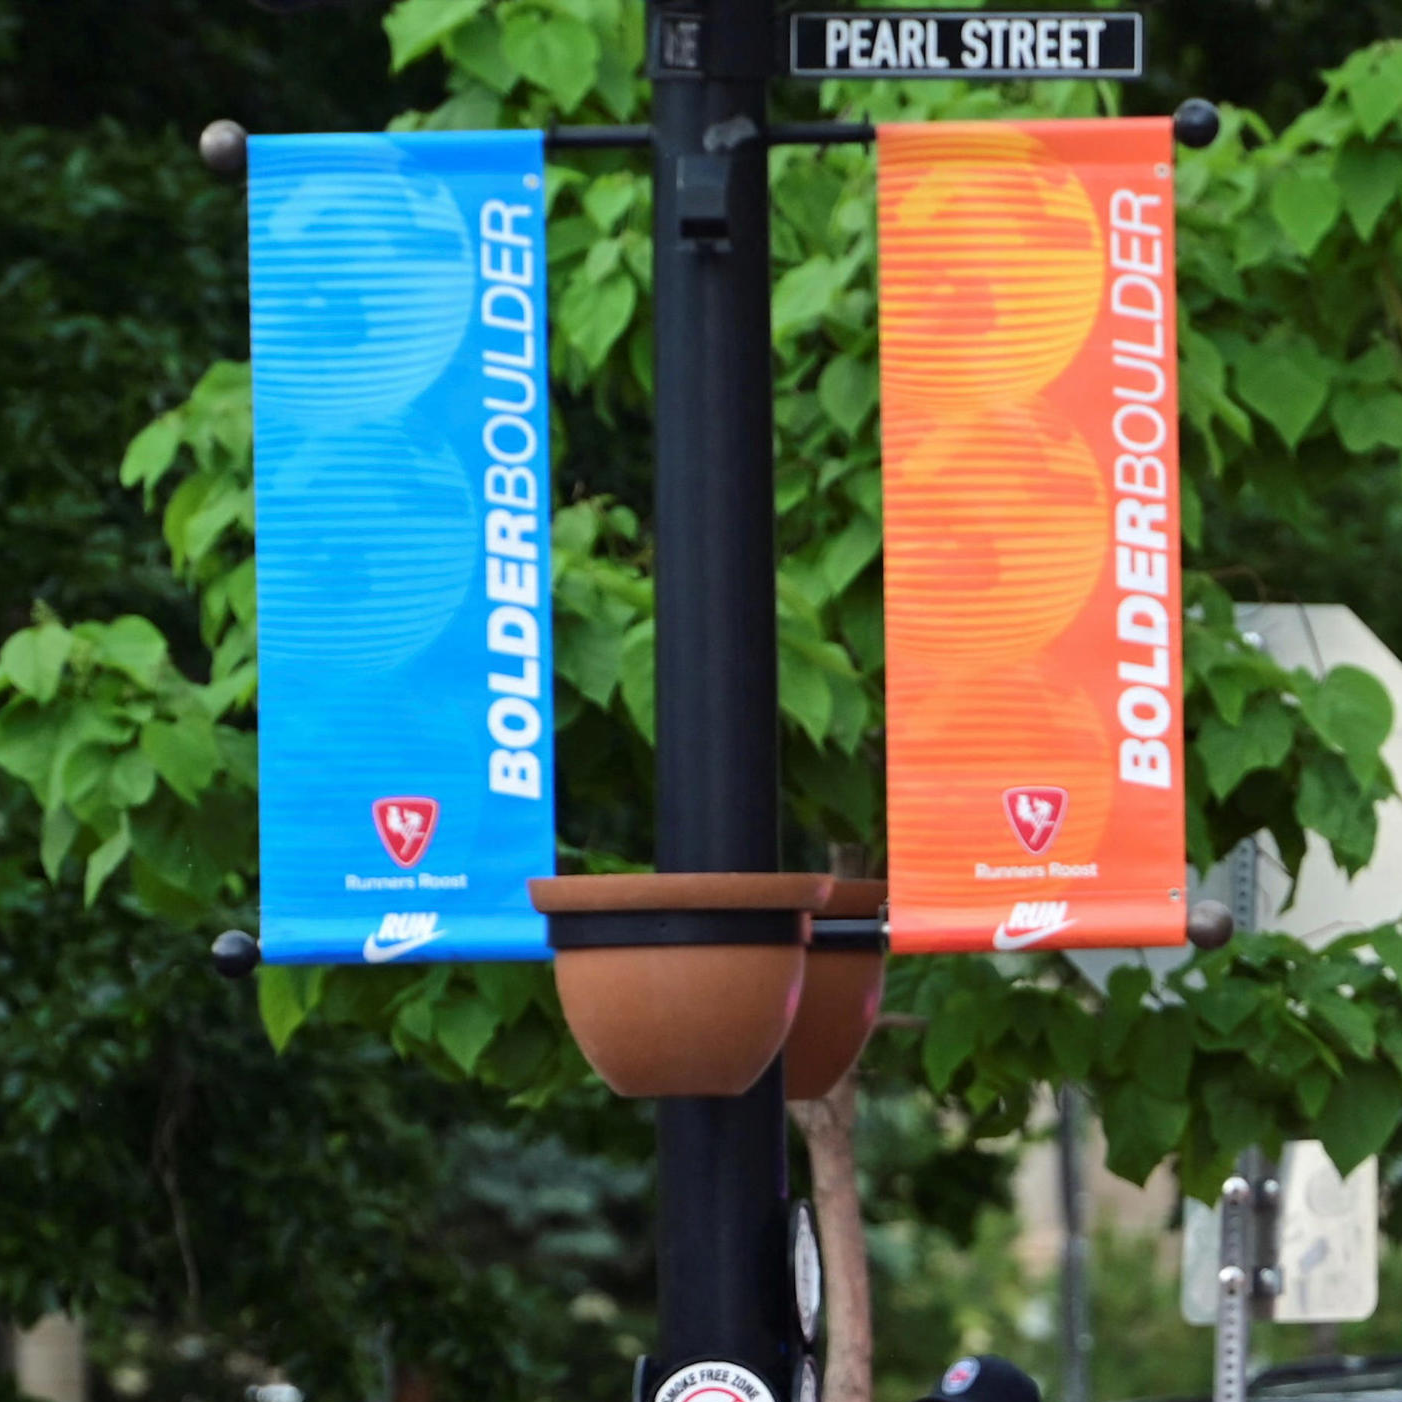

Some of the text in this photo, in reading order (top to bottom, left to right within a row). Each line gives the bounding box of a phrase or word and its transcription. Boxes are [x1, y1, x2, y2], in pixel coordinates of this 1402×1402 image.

[825, 19, 1106, 68] PEARL STREET
[481, 198, 542, 799] BOLDERBOULDER
[1109, 187, 1172, 789] BOLDERBOULDER
[345, 872, 468, 891] Runners Roost
[975, 862, 1098, 878] Runners Roost
[378, 912, 439, 940] RUN
[1009, 901, 1069, 928] RUN
[699, 1369, 730, 1382] FREE
[731, 1375, 761, 1401] ZONE
